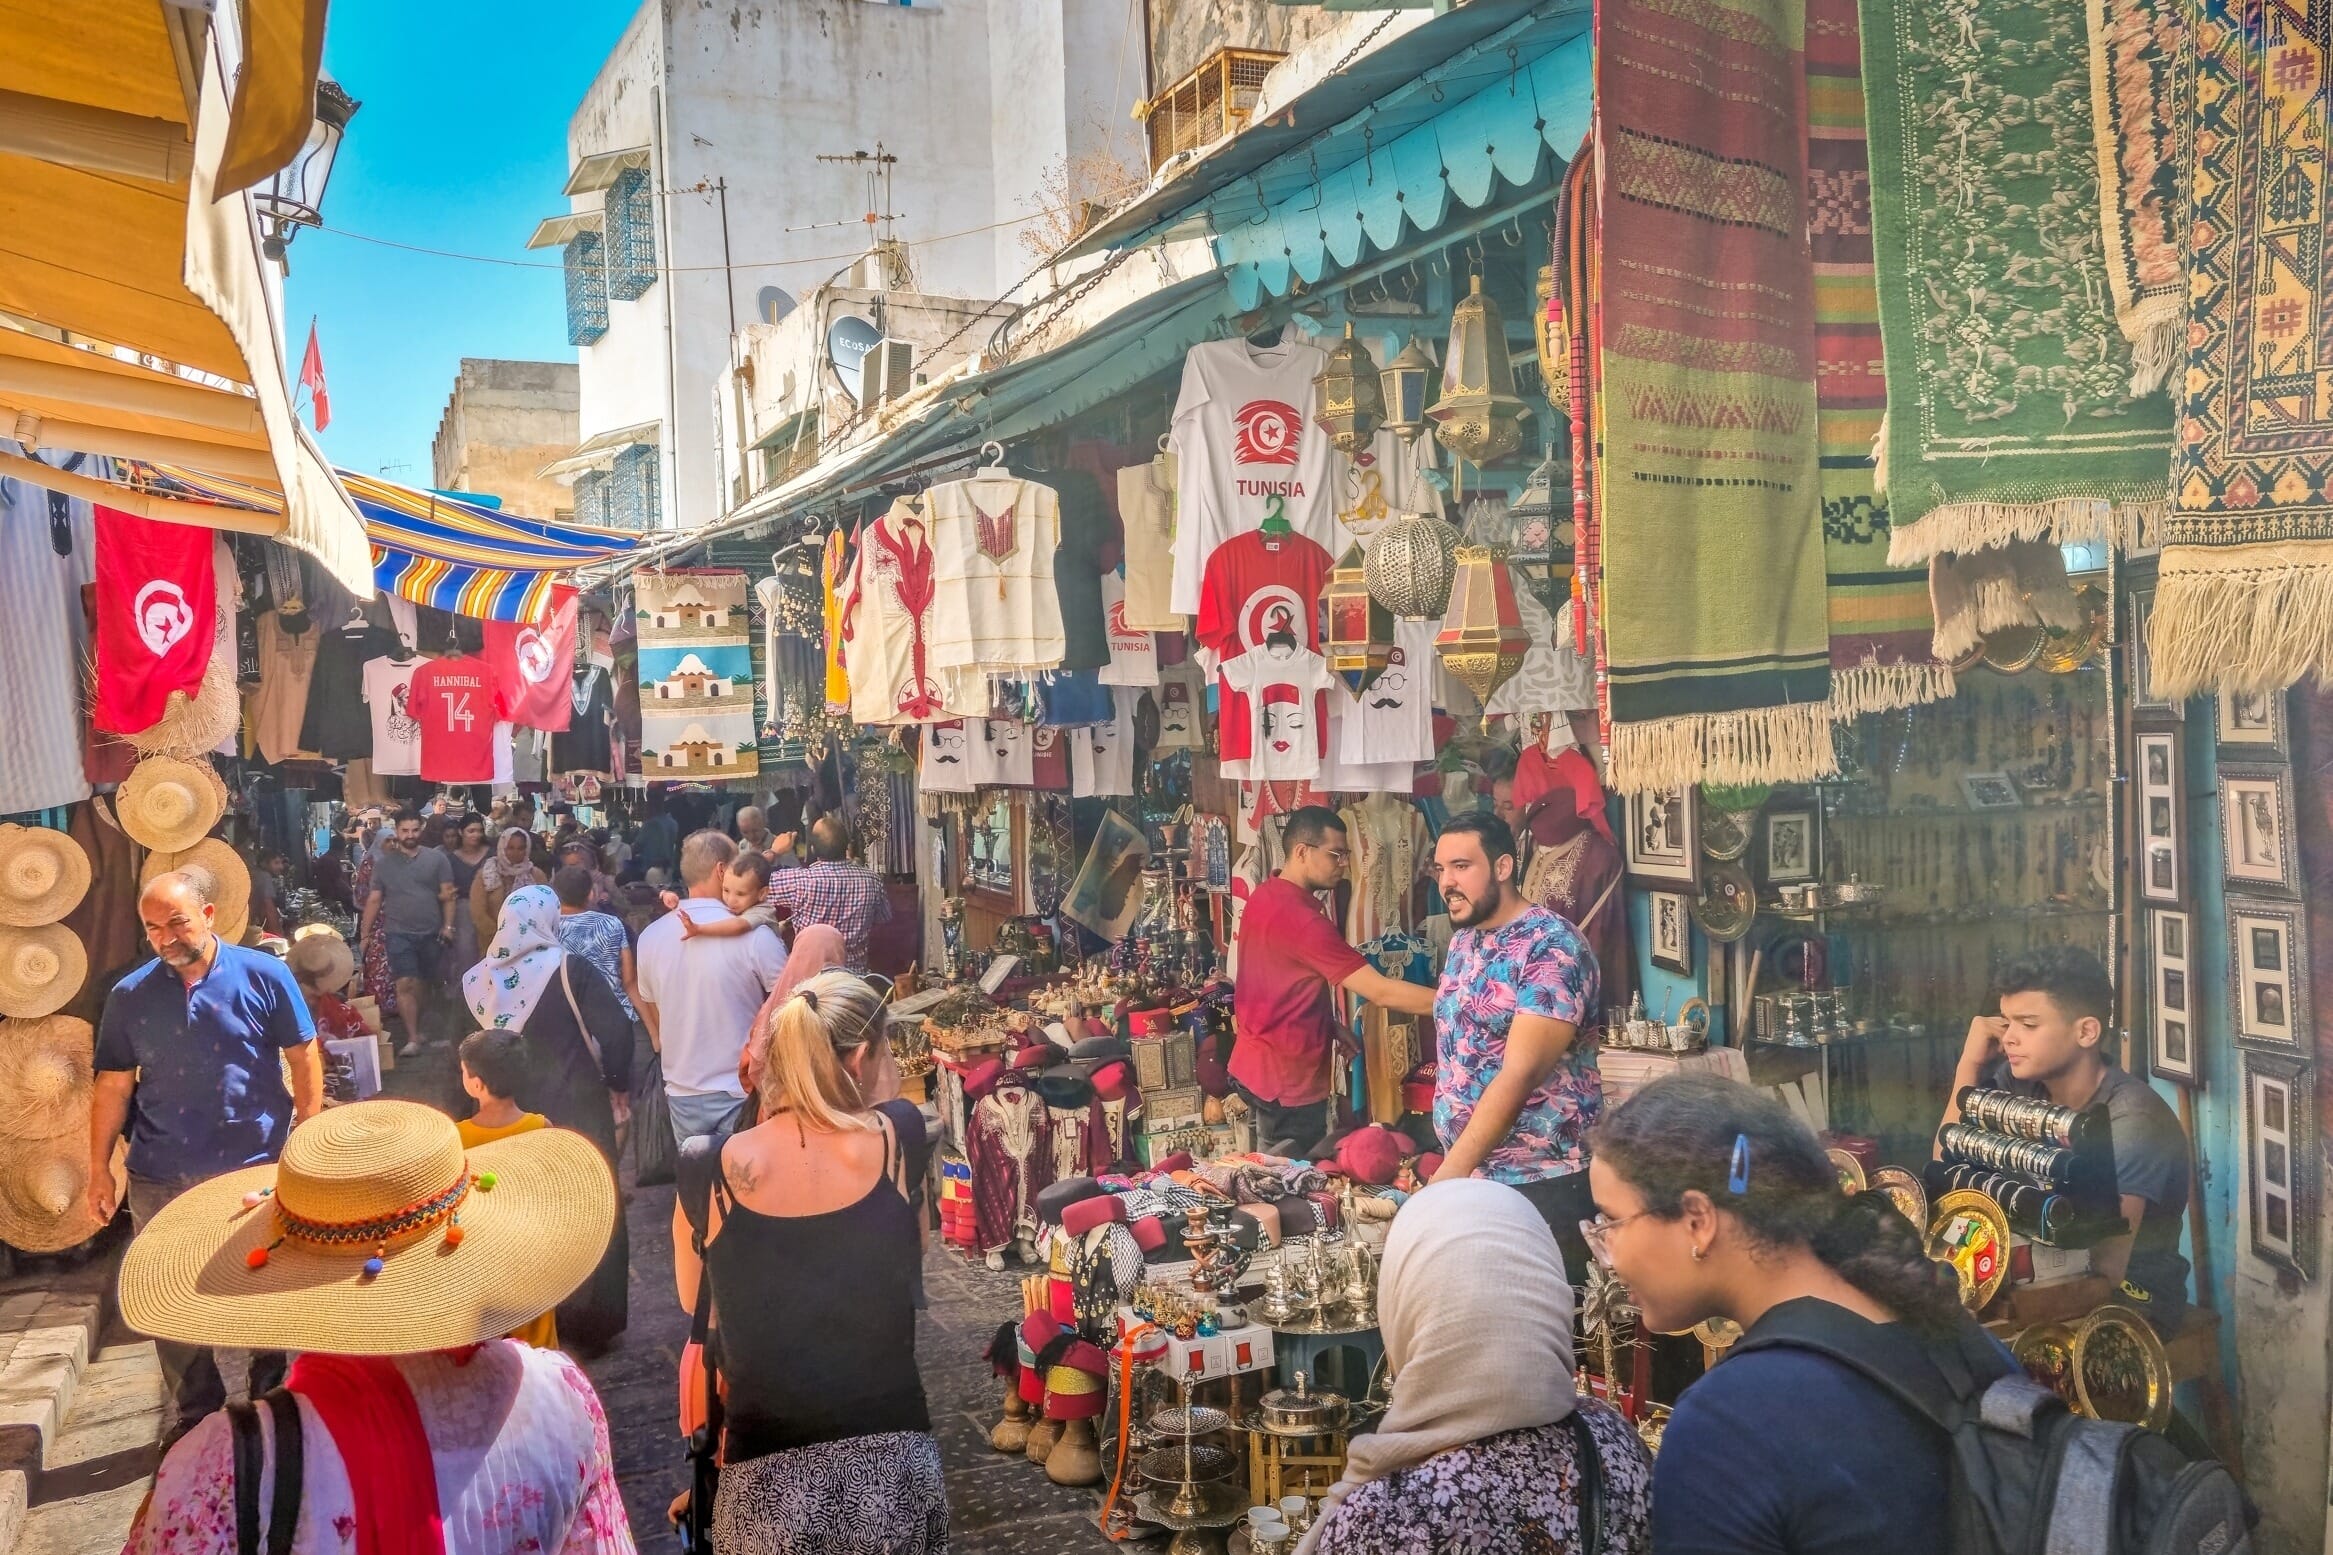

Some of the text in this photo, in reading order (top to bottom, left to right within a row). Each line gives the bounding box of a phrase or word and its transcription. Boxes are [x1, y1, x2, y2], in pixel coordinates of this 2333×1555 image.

[839, 336, 875, 353] ECOSA
[1236, 479, 1306, 497] TUNISIA
[1111, 642, 1150, 652] TUNISIA
[433, 675, 482, 688] HANNIBAL
[441, 692, 475, 732] 14
